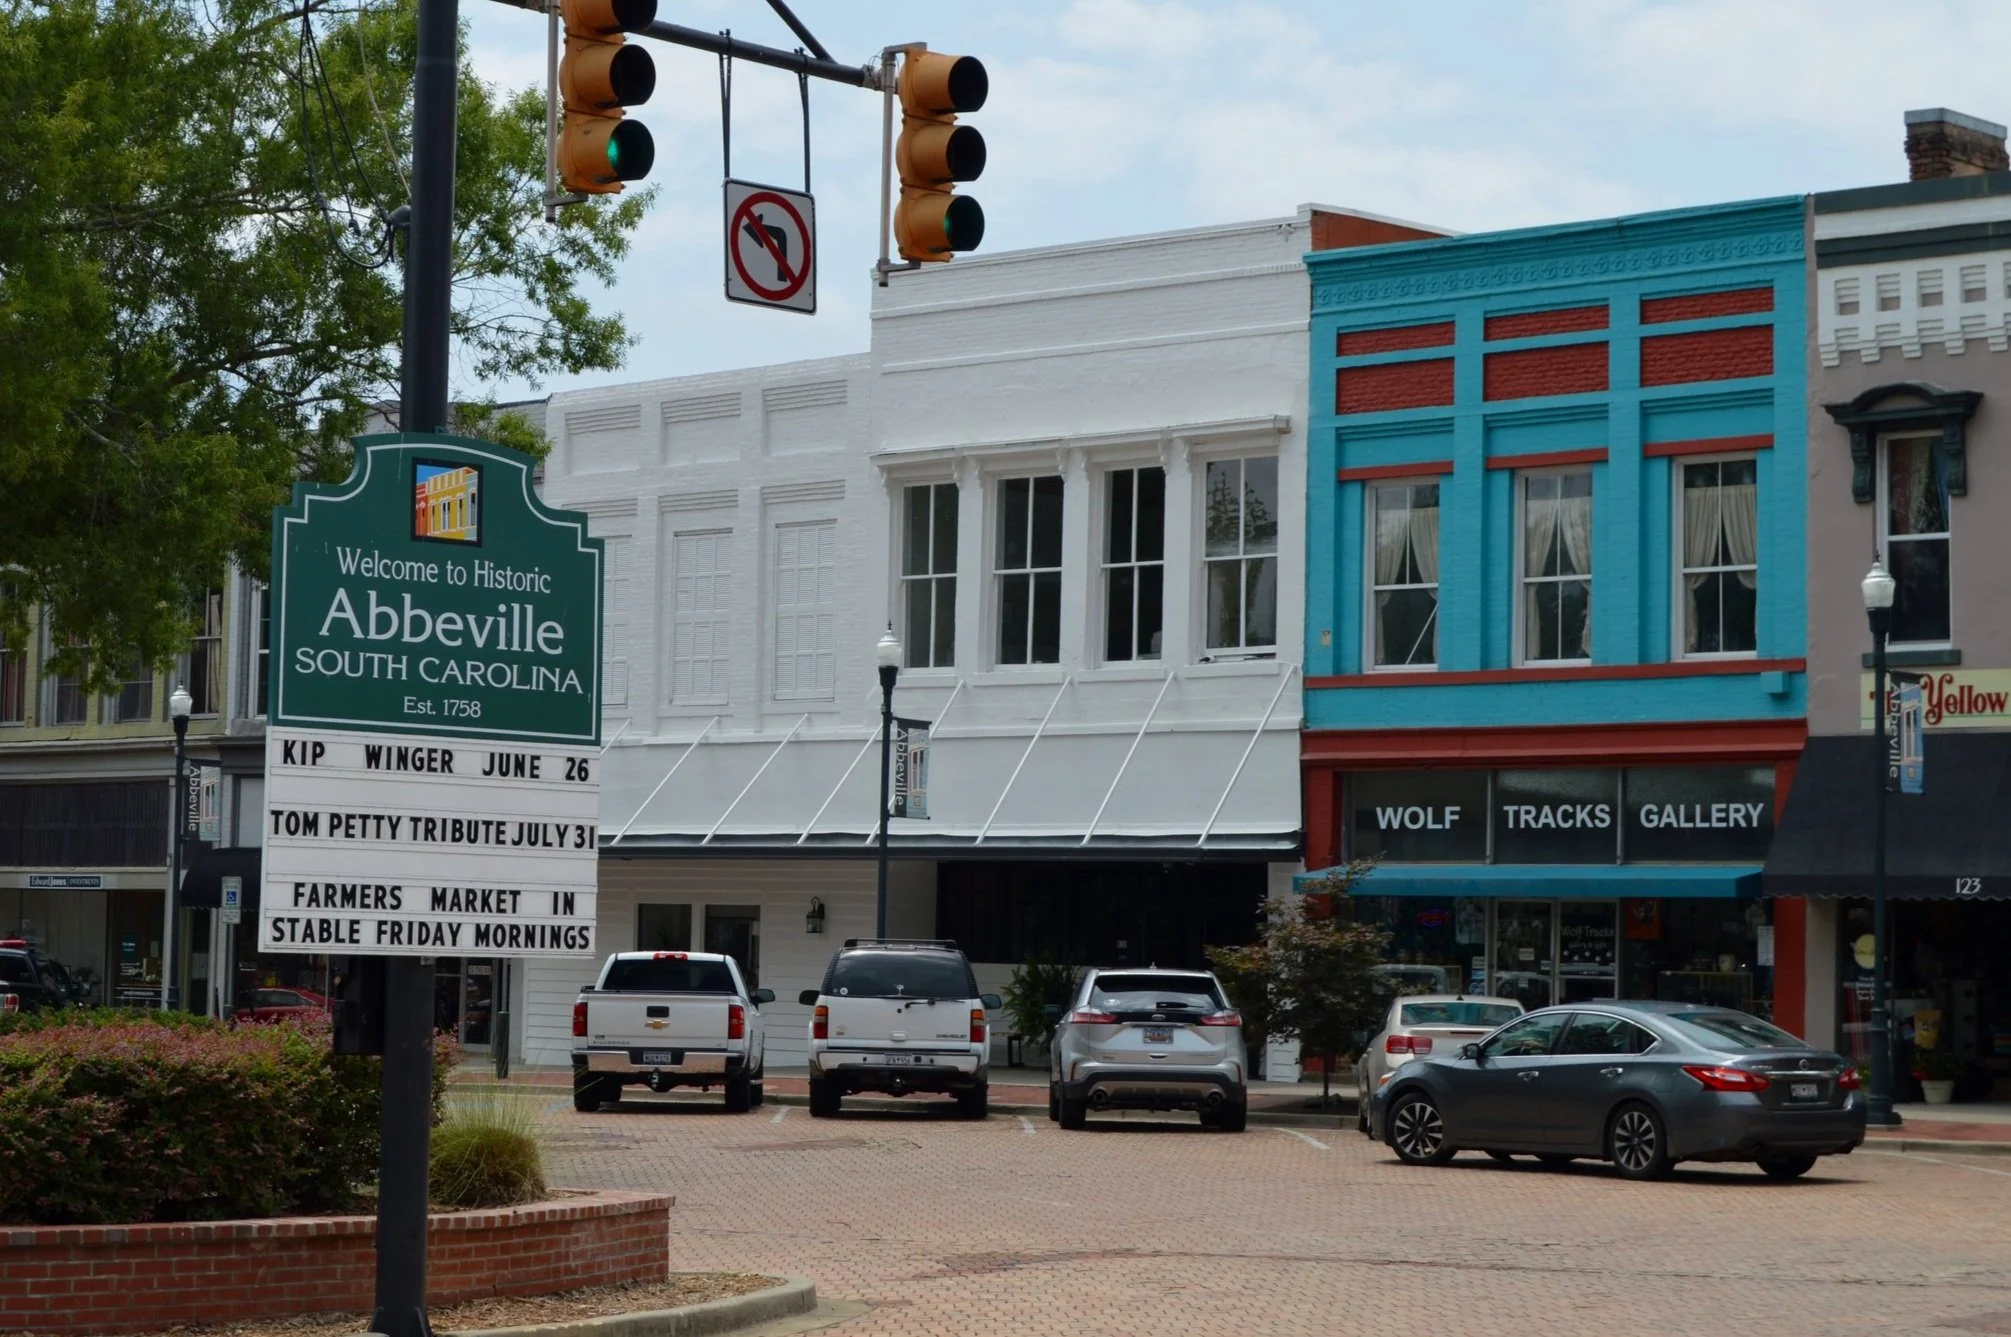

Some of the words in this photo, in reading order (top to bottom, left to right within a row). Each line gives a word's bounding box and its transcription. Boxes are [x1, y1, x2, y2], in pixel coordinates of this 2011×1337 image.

[336, 546, 439, 583] Welcome
[446, 559, 467, 586] to
[474, 559, 552, 594] Historic
[318, 587, 565, 655] Abbeville
[295, 647, 408, 682] SOUTH
[418, 657, 584, 694] CAROLINA
[403, 696, 436, 716] Est.
[442, 699, 482, 718] 1758
[1920, 673, 2009, 725] Yellow
[1889, 683, 1901, 779] Abbeville
[282, 739, 326, 766] KIP
[365, 744, 454, 774] WINGER
[482, 752, 541, 779] JUNE
[564, 757, 589, 782] 26
[895, 727, 908, 806] Abbeville
[188, 766, 200, 832] Abbeville
[1376, 806, 1461, 830] WOLF
[1503, 804, 1611, 829] TRACKS
[1639, 802, 1764, 829] GALLERY
[270, 809, 319, 838] TOM
[329, 812, 402, 840] PETTY
[409, 816, 507, 846] TRIBUTE
[511, 822, 570, 848] JULY
[573, 825, 595, 850] 31
[293, 881, 403, 911] FARMERS
[430, 887, 521, 914] MARKET
[552, 891, 575, 916] IN
[1956, 877, 1982, 895] 123
[271, 917, 361, 945] STABLE
[376, 920, 462, 947] FRIDAY
[474, 923, 590, 950] MORNINGS
